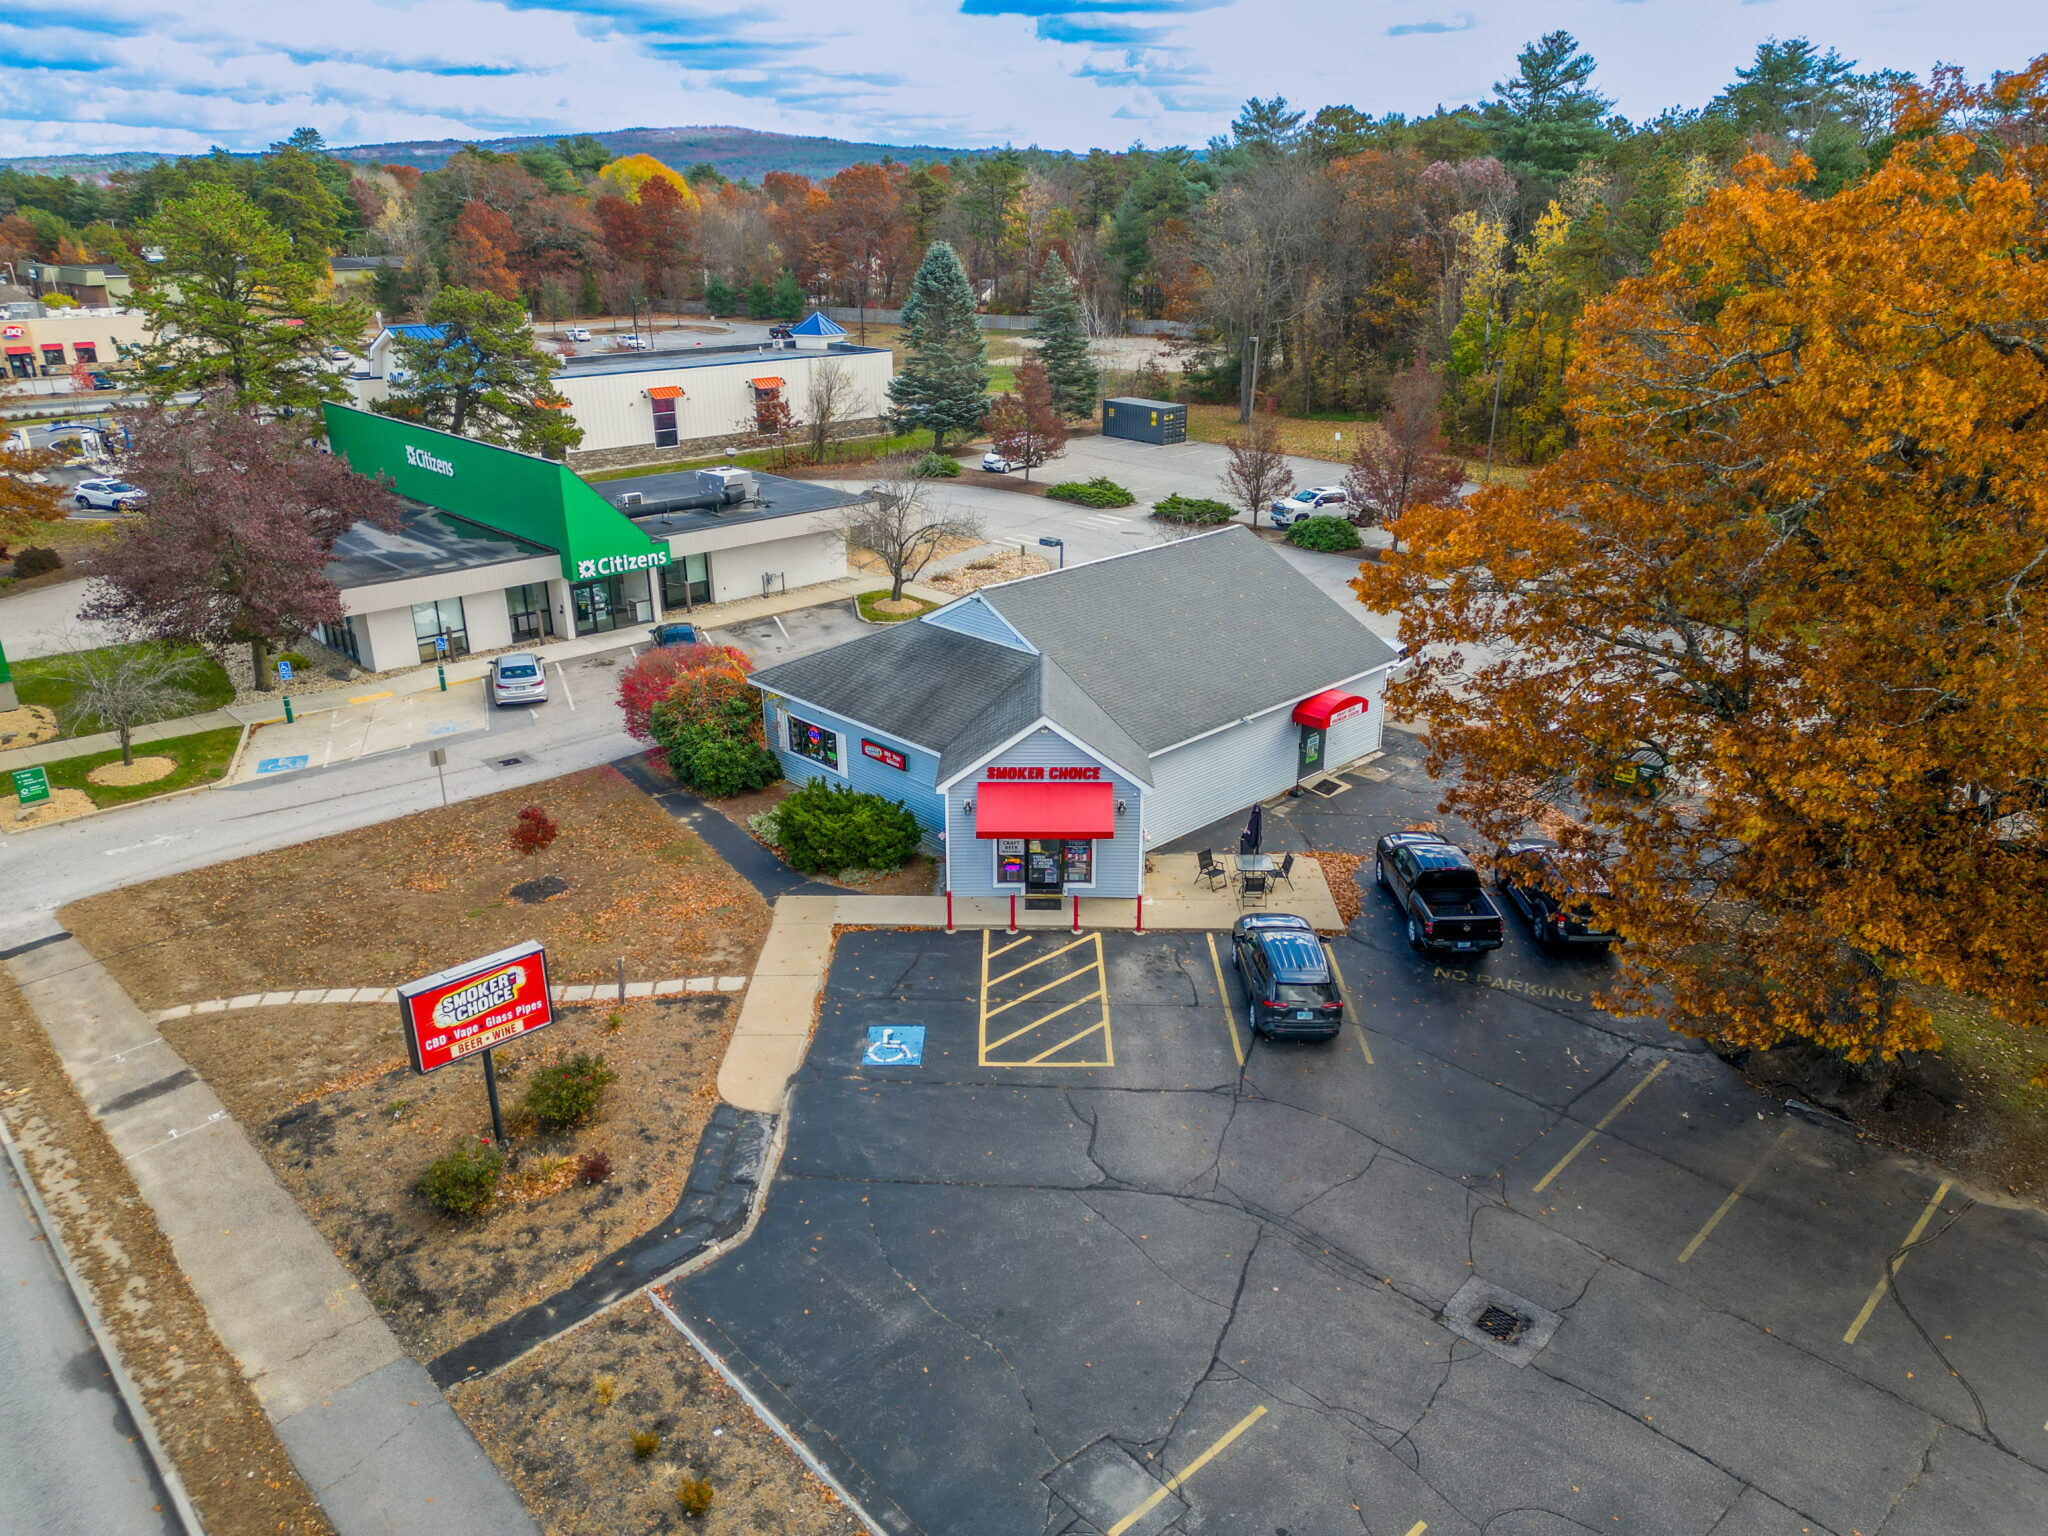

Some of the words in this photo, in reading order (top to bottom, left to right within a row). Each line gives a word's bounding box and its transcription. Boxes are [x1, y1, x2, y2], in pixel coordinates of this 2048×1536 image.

[6, 328, 22, 336] DQ
[416, 449, 454, 477] Citizens
[597, 551, 667, 575] Citizens
[986, 766, 1045, 780] SMOKER
[1048, 766, 1101, 780] CHOICE
[442, 973, 511, 1013] SMOKER
[1433, 967, 1468, 981] NO
[1476, 974, 1583, 1001] PARKING
[455, 985, 514, 1021] CHOICE
[425, 1036, 447, 1051] CBD
[453, 1023, 479, 1040] Vape
[485, 1011, 513, 1028] Glass
[515, 1000, 543, 1017] Pipes
[458, 1037, 483, 1054] BEER
[492, 1024, 517, 1041] WINE
